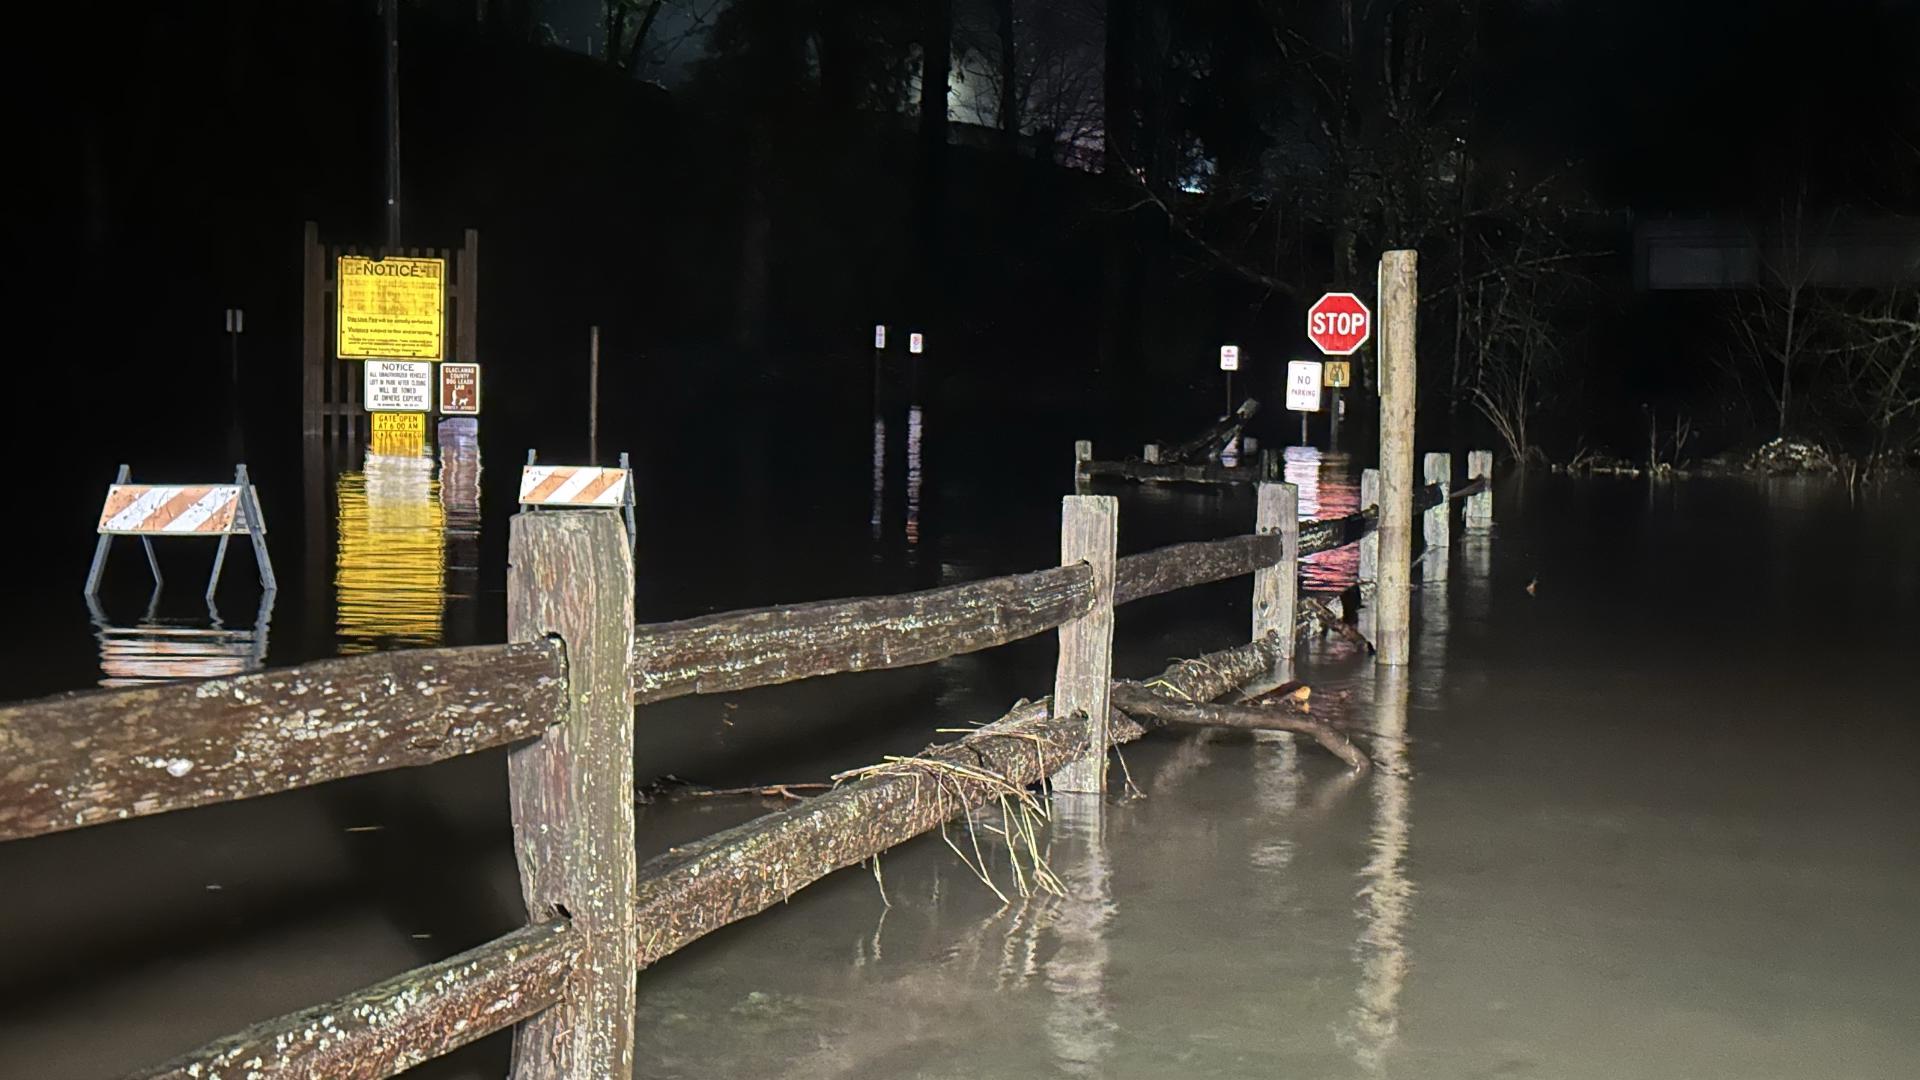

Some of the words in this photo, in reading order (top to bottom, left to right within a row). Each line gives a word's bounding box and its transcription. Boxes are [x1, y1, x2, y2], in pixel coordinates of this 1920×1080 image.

[1312, 312, 1365, 336] STOP
[382, 363, 414, 371] NOTICE
[1297, 376, 1311, 385] NO
[1291, 388, 1316, 397] PARKING
